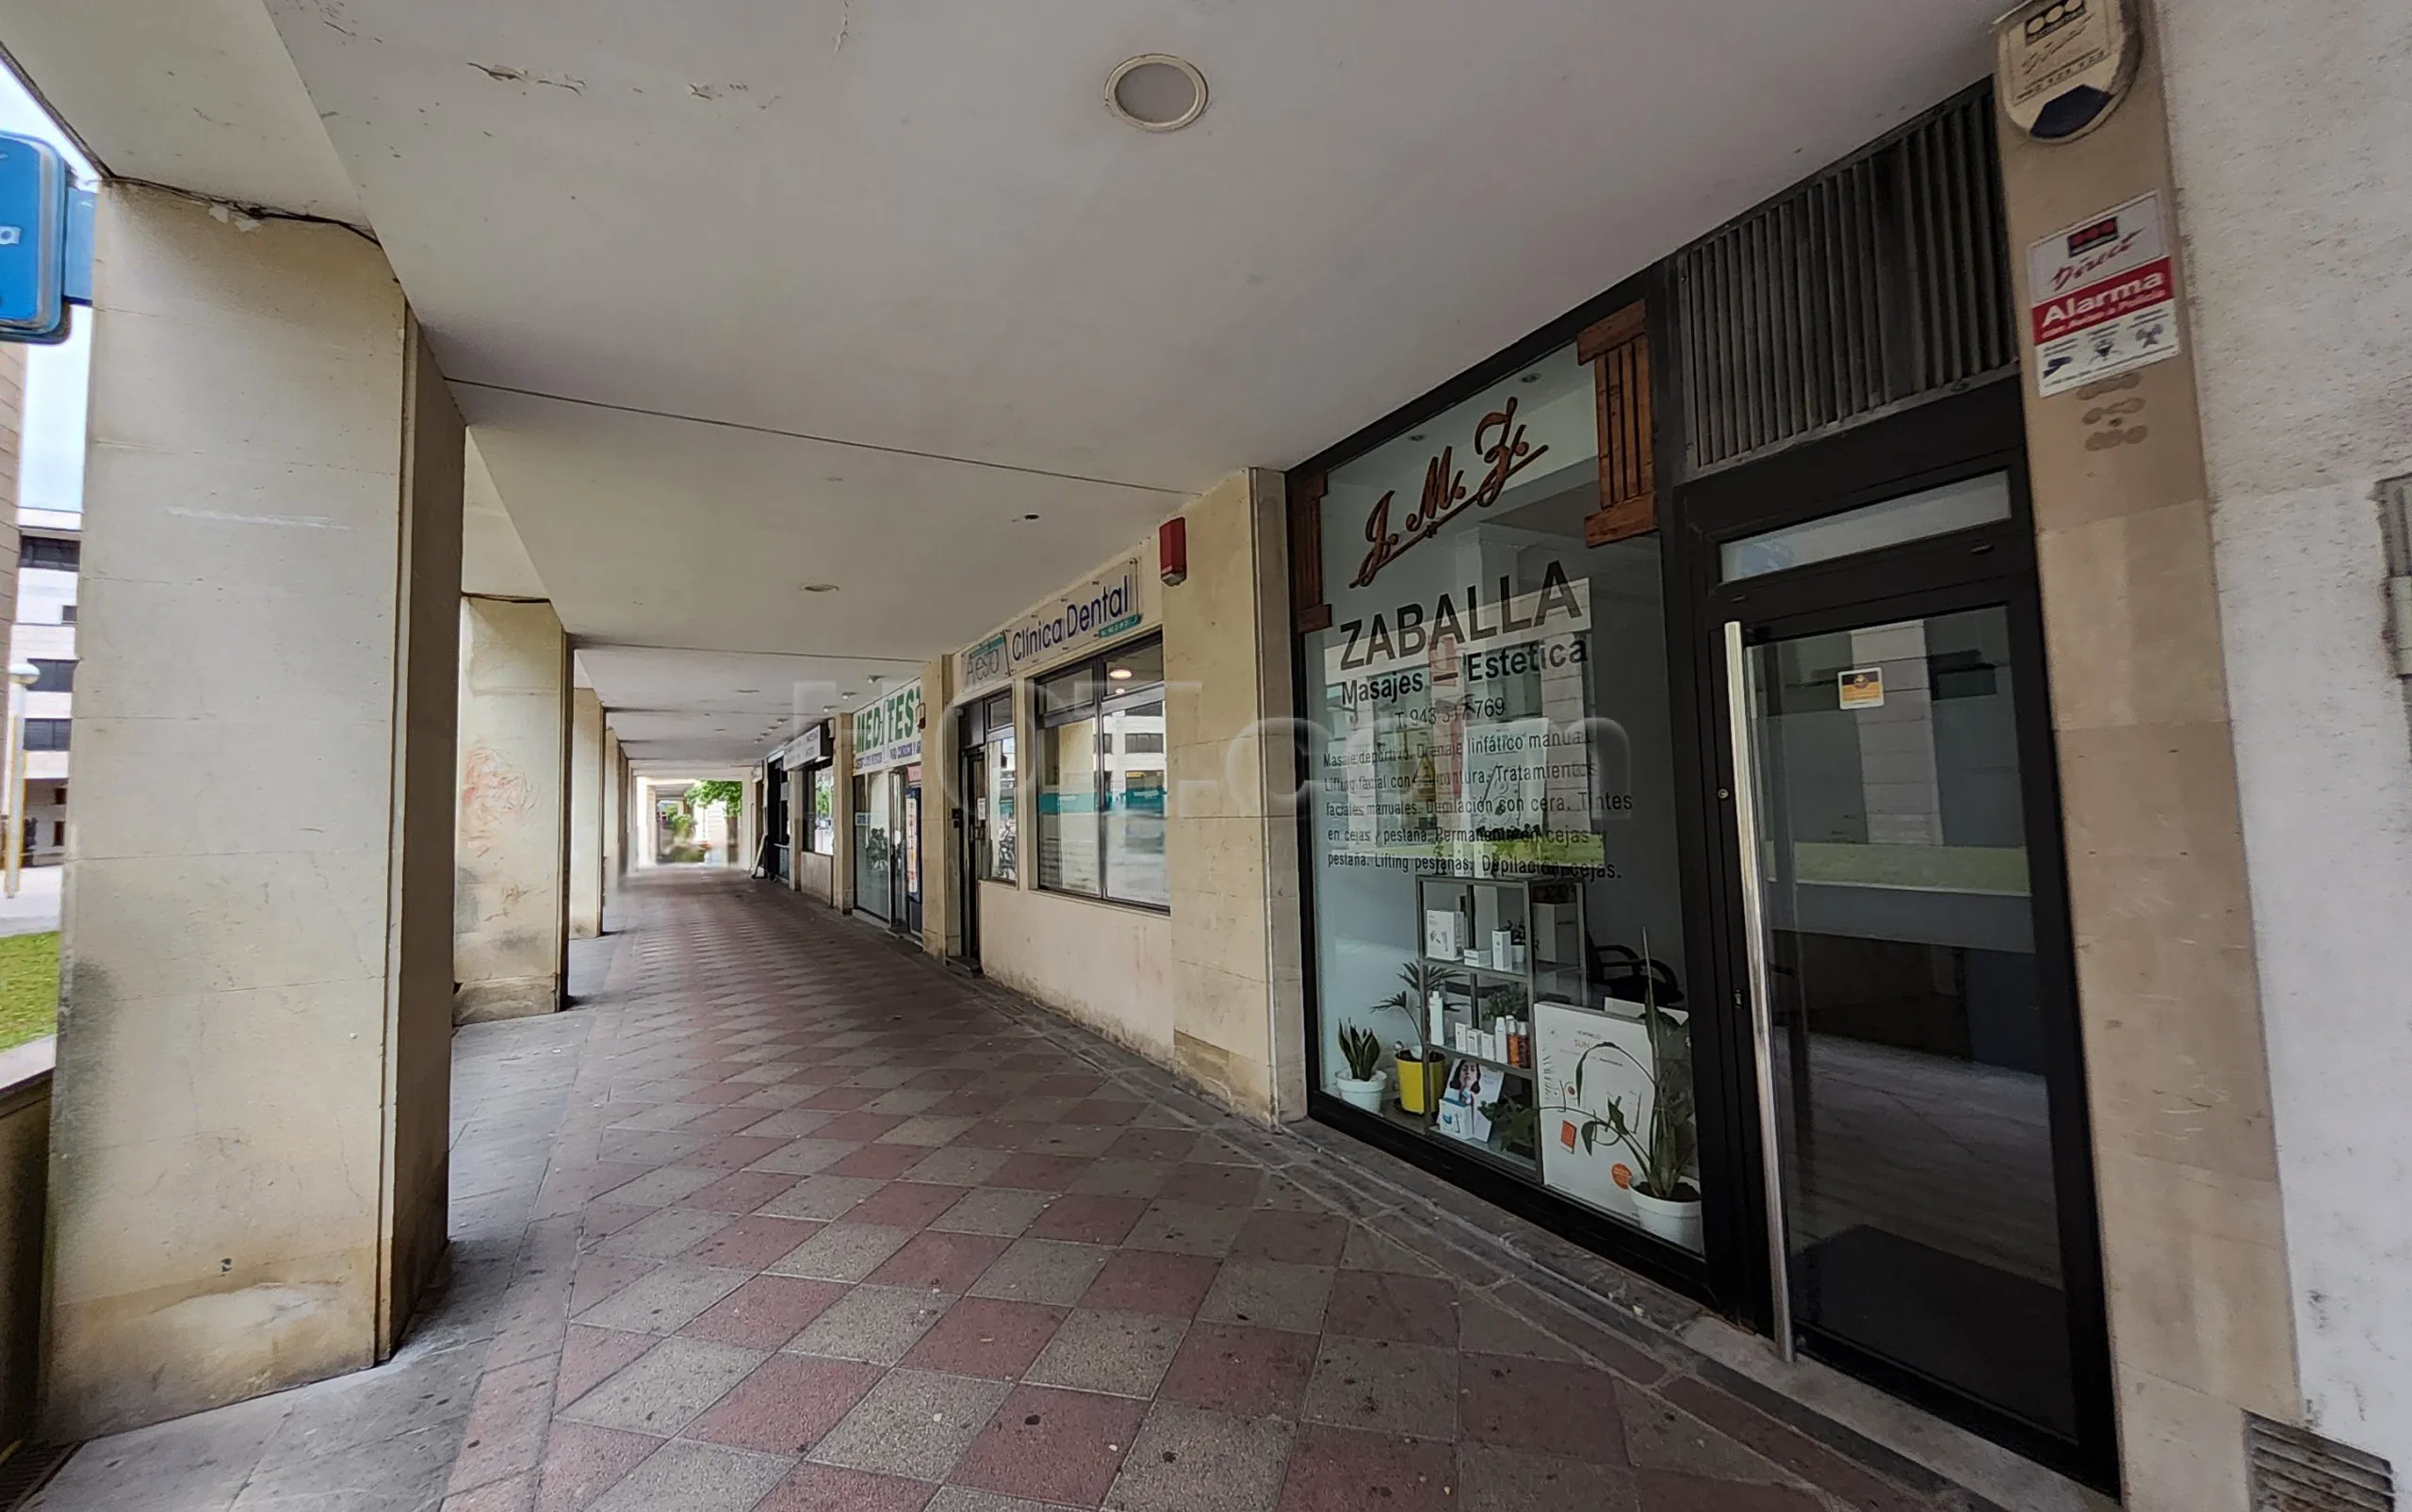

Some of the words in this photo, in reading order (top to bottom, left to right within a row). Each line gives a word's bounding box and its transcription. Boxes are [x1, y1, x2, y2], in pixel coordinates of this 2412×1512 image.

[2041, 271, 2166, 328] Alarma
[1012, 619, 1063, 661] Clínica
[1067, 575, 1129, 638] Dental
[1339, 560, 1583, 671] ZABALLA
[1342, 672, 1424, 706] Masajes
[1410, 707, 1437, 725] 943
[1474, 697, 1506, 719] 769
[1467, 733, 1524, 755] linfático
[1390, 776, 1411, 789] con
[1530, 796, 1571, 812] cera.
[1328, 829, 1340, 841] en
[1345, 828, 1371, 845] cejas
[1545, 825, 1590, 848] cejas
[1328, 852, 1371, 869] pestaña.
[1375, 853, 1410, 873] Lifting
